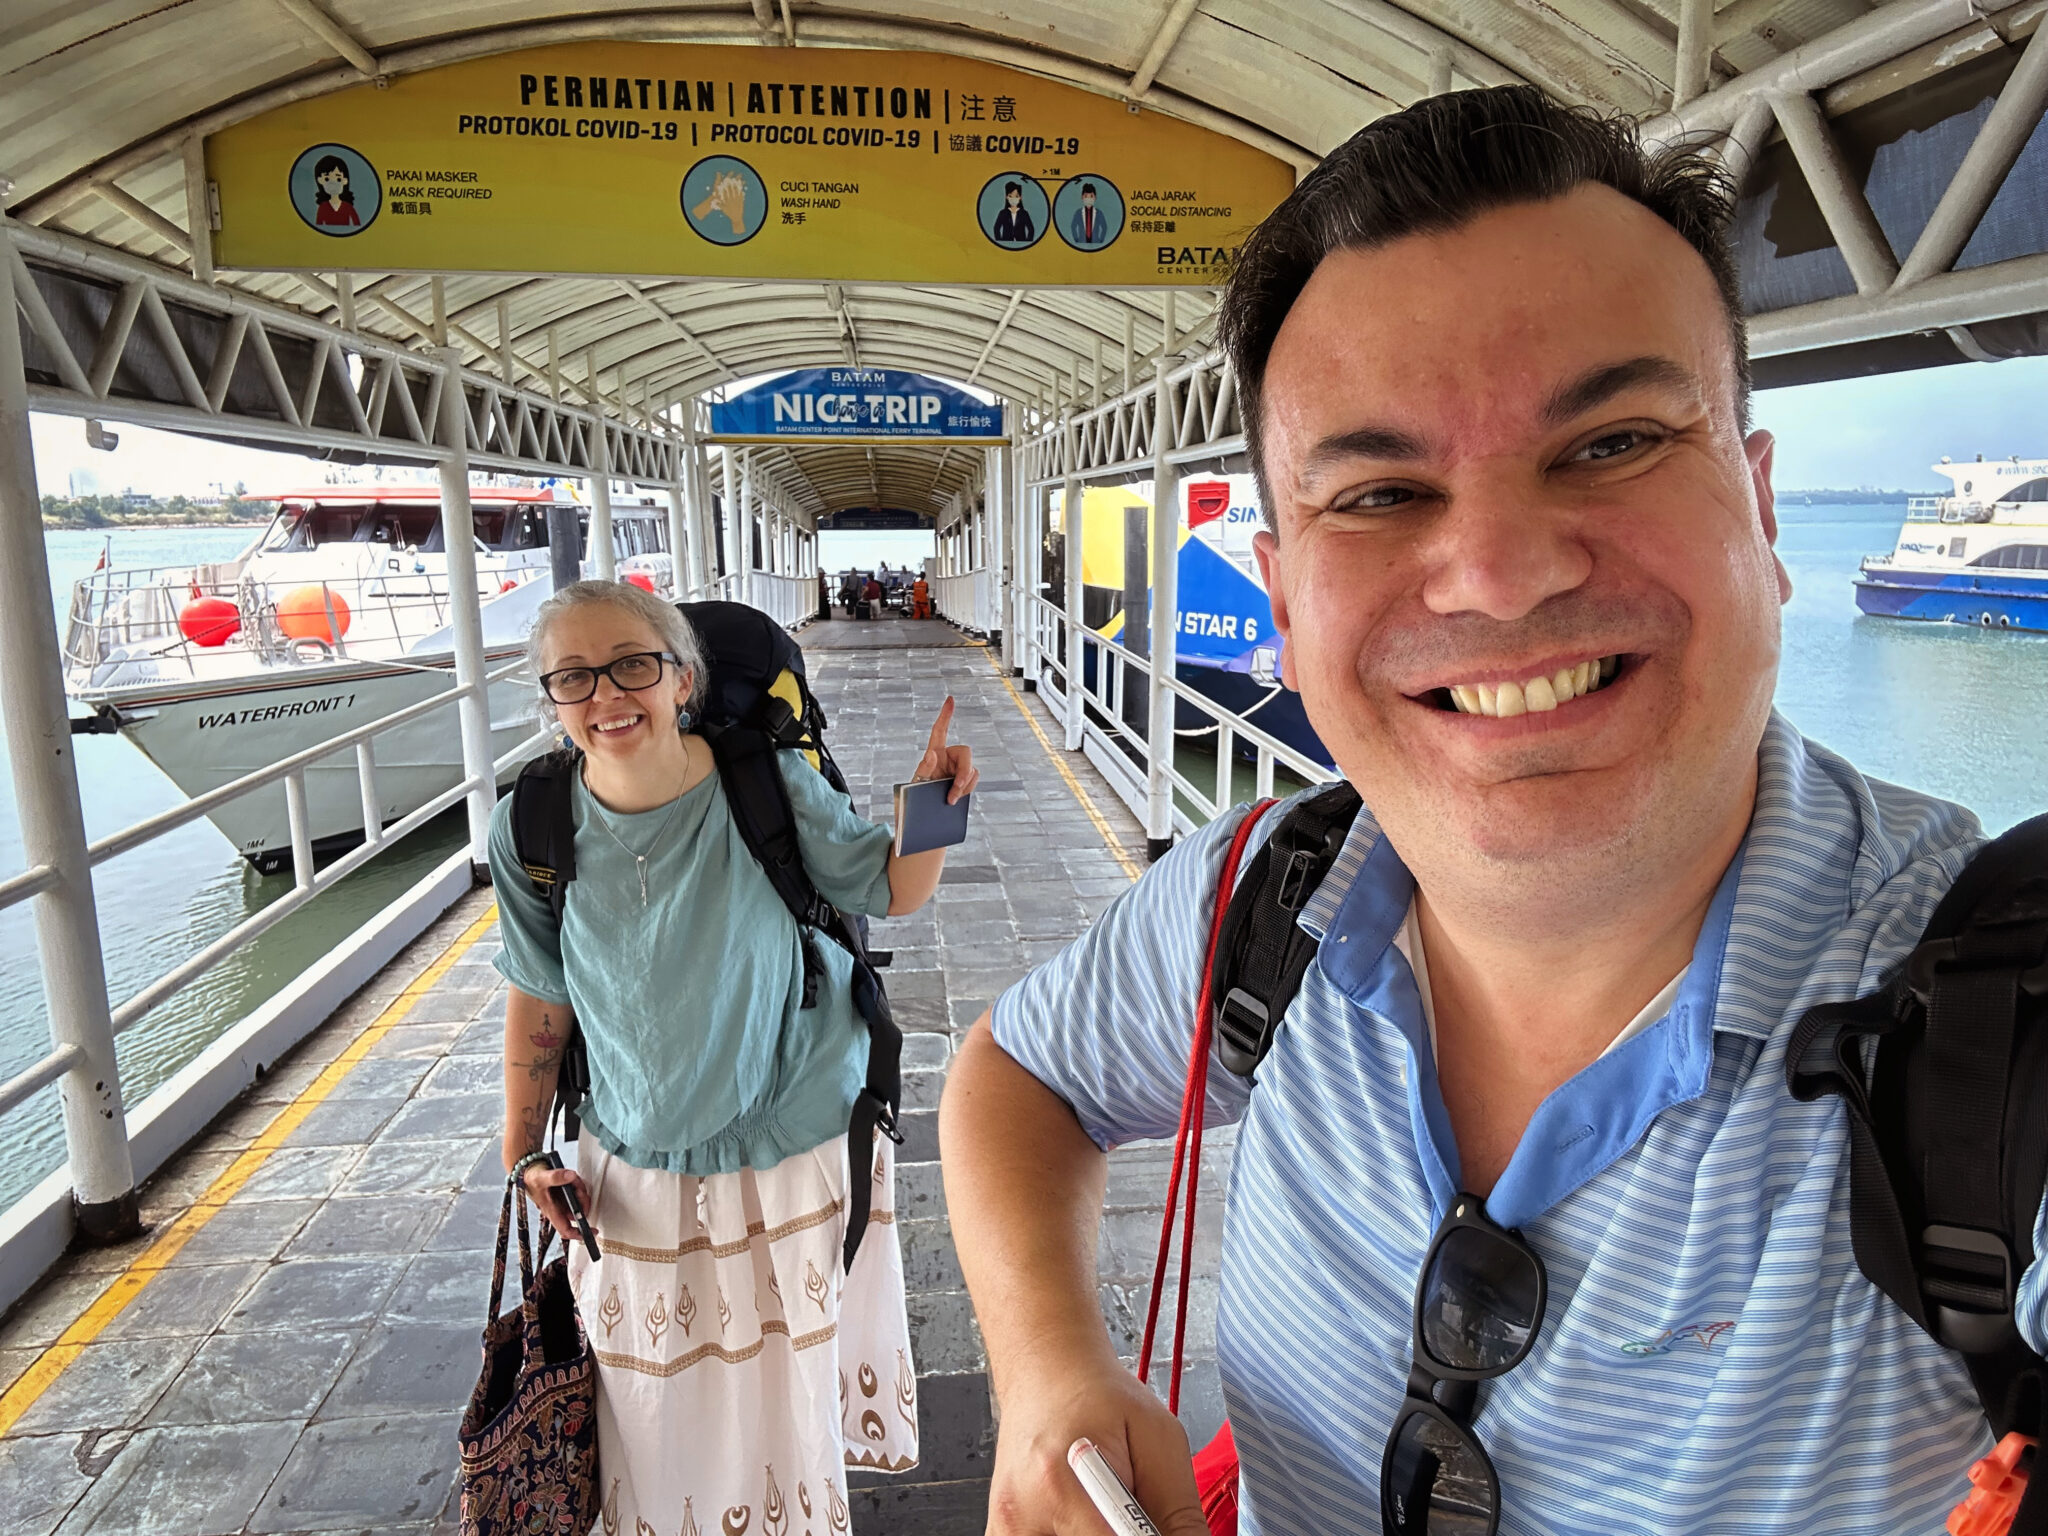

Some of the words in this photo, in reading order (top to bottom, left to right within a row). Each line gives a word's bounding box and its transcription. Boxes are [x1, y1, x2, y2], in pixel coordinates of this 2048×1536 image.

[520, 74, 715, 112] PERHATIAN
[747, 82, 931, 119] ATTENTION
[960, 94, 1017, 123] 注意
[458, 115, 571, 137] PROTOKOL
[576, 119, 678, 141] COVID-19
[711, 124, 818, 145] PROTOCOL
[823, 127, 921, 148] COVID-19
[949, 134, 983, 153] 協議
[985, 135, 1080, 155] COVID-19
[386, 170, 422, 181] PAKAI
[425, 170, 479, 183] MASKER
[389, 186, 424, 198] MASK
[427, 187, 493, 200] REQUIRED
[780, 181, 809, 192] CUCI
[811, 182, 859, 194] TANGAN
[781, 197, 810, 208] WASH
[812, 198, 841, 209] HAND
[1130, 190, 1159, 201] JAGA
[1161, 190, 1197, 202] JARAK
[781, 211, 807, 225] 洗手
[1130, 205, 1168, 217] SOCIAL
[1170, 206, 1232, 218] DISTANCING
[831, 371, 886, 382] BATAM
[773, 393, 857, 424] NICE
[864, 394, 942, 424] TRIP
[832, 397, 869, 420] have
[912, 427, 943, 435] TERMINAL
[1184, 611, 1237, 639] STAR
[1244, 617, 1258, 642] 6
[198, 695, 345, 729] WATERFRONT
[347, 694, 355, 707] 1
